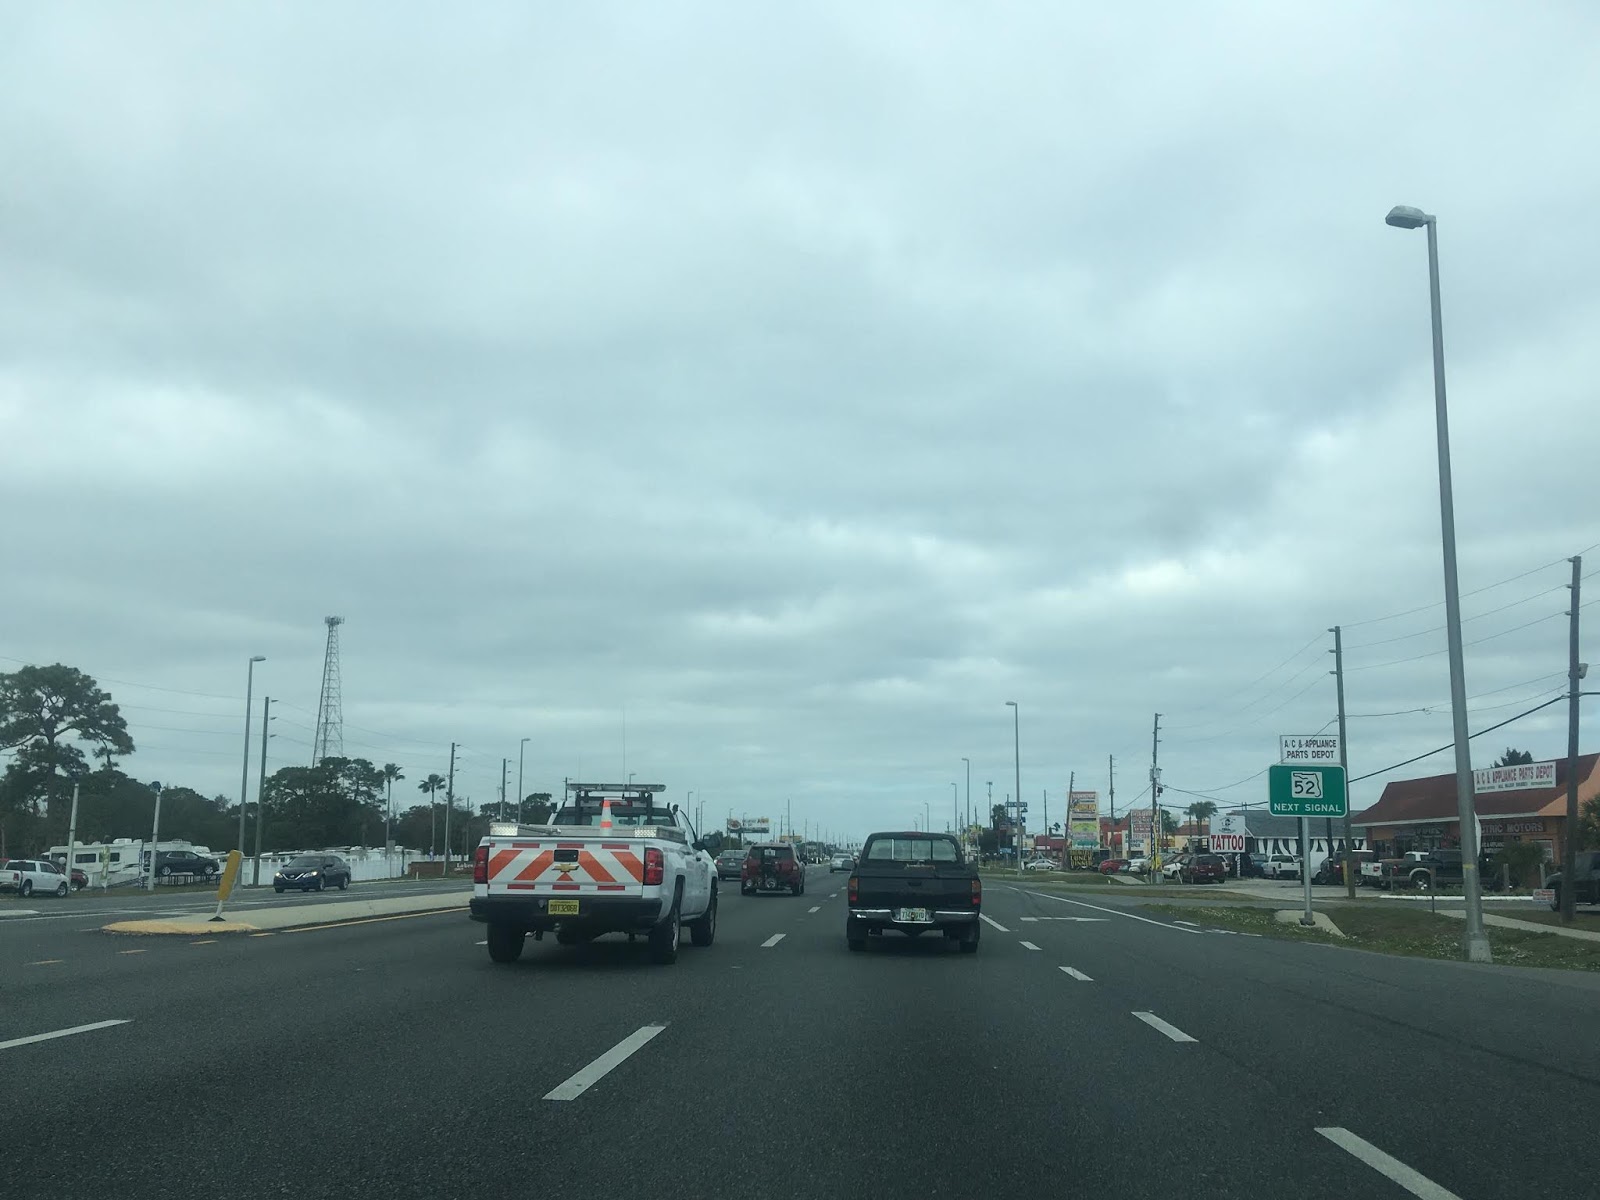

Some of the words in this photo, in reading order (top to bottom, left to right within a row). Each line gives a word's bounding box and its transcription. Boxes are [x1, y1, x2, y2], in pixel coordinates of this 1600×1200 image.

[1305, 739, 1337, 748] APPLIANCE
[1287, 750, 1309, 759] PARTS
[1311, 750, 1334, 759] DEPOT
[1492, 768, 1517, 783] APPLIANCE
[1518, 766, 1534, 780] PARTS
[1535, 764, 1554, 779] DEPOT
[1294, 780, 1315, 794] 52
[1274, 803, 1300, 811] NEXT
[1305, 803, 1342, 812] SIGNAL
[1506, 822, 1544, 832] MOTORS
[1211, 835, 1244, 850] TATTOO
